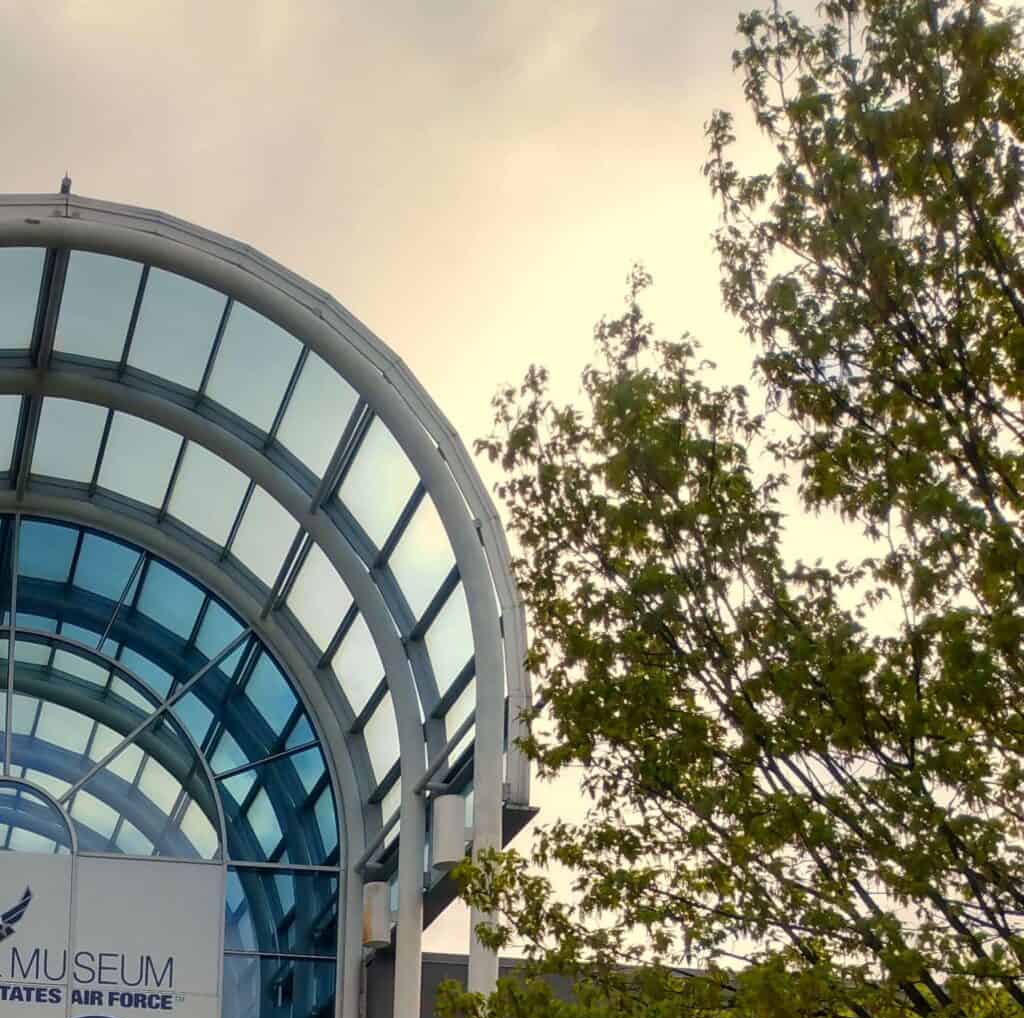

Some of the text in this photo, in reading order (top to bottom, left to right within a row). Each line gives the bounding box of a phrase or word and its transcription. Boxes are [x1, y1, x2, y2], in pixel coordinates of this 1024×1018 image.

[10, 947, 174, 988] MUSEUM
[71, 989, 100, 1006] AIR
[108, 991, 174, 1010] FORCE
